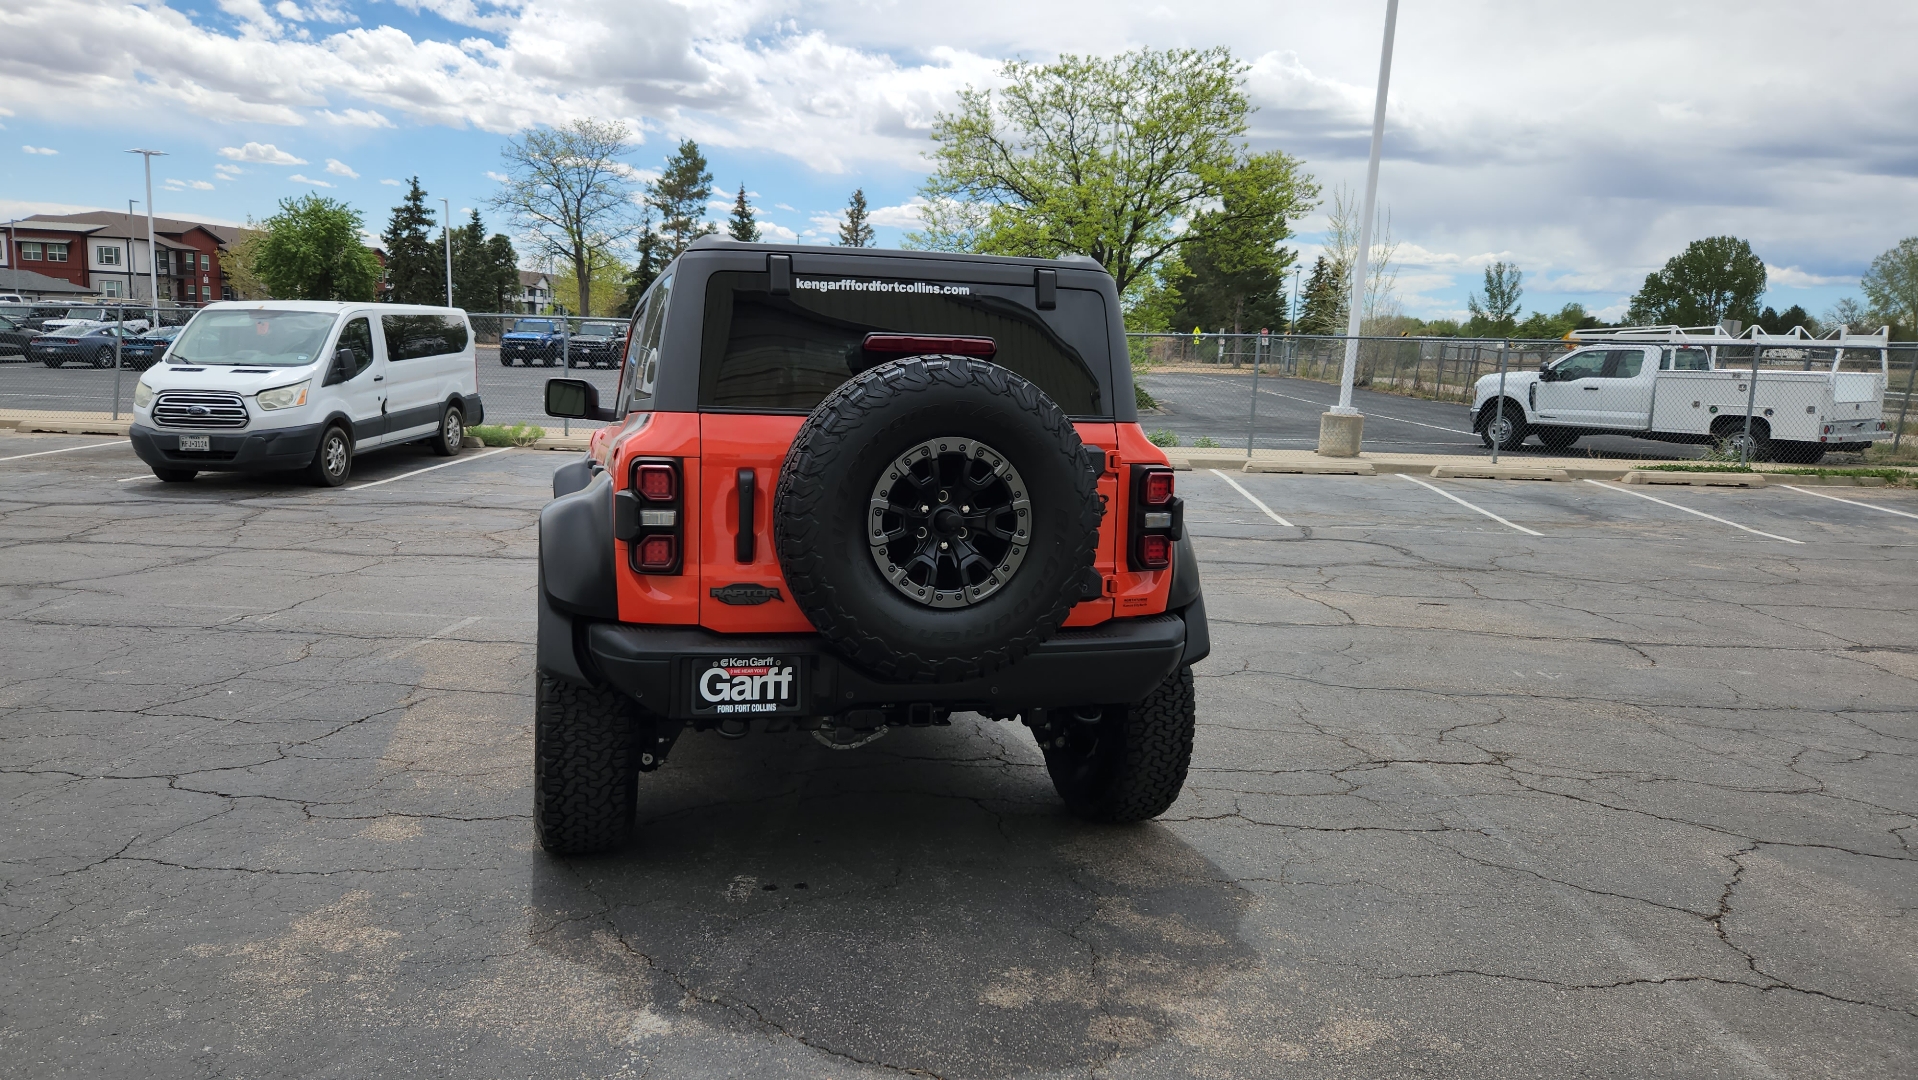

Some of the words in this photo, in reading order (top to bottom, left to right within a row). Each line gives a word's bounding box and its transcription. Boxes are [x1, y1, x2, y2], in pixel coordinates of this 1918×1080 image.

[795, 278, 970, 296] kengarfffordfortcollins.com
[710, 587, 782, 600] RAPTOR
[730, 657, 749, 667] Ken
[750, 656, 774, 667] Garff
[700, 667, 793, 702] Garff
[717, 704, 734, 713] FORD
[735, 704, 750, 713] FORT
[751, 703, 777, 712] COLLINS
